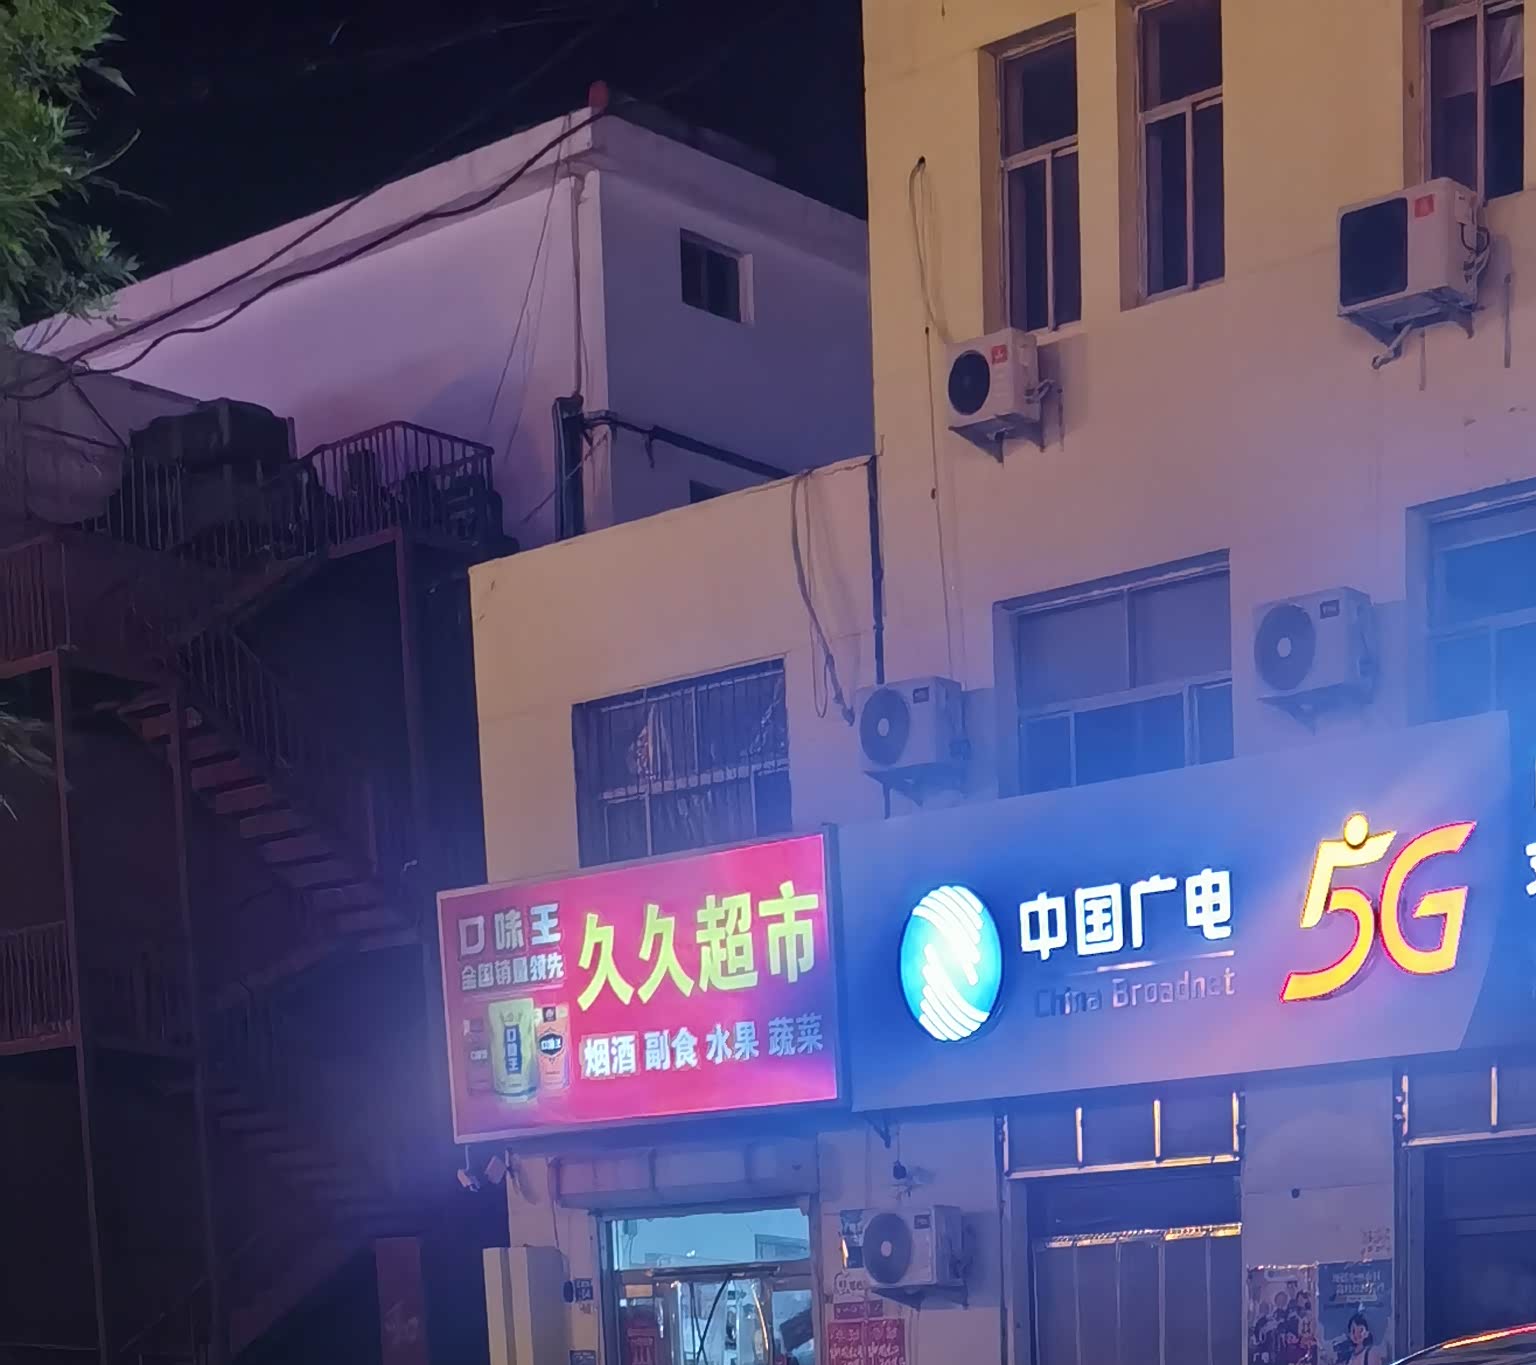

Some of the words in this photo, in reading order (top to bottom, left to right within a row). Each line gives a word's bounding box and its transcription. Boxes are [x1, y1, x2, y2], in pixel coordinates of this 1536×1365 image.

[458, 903, 561, 956] 口味王
[1020, 869, 1231, 960] 中国广电
[1280, 812, 1476, 1002] 5G
[462, 952, 564, 991] 全国销量领先
[577, 881, 819, 1011] 久久超市
[1035, 986, 1100, 1017] China
[1112, 967, 1236, 1008] Broadnet
[584, 1032, 638, 1077] 烟酒
[645, 1028, 698, 1071] 副食
[706, 1021, 760, 1062] 水果
[768, 1013, 823, 1055] 蔬菜
